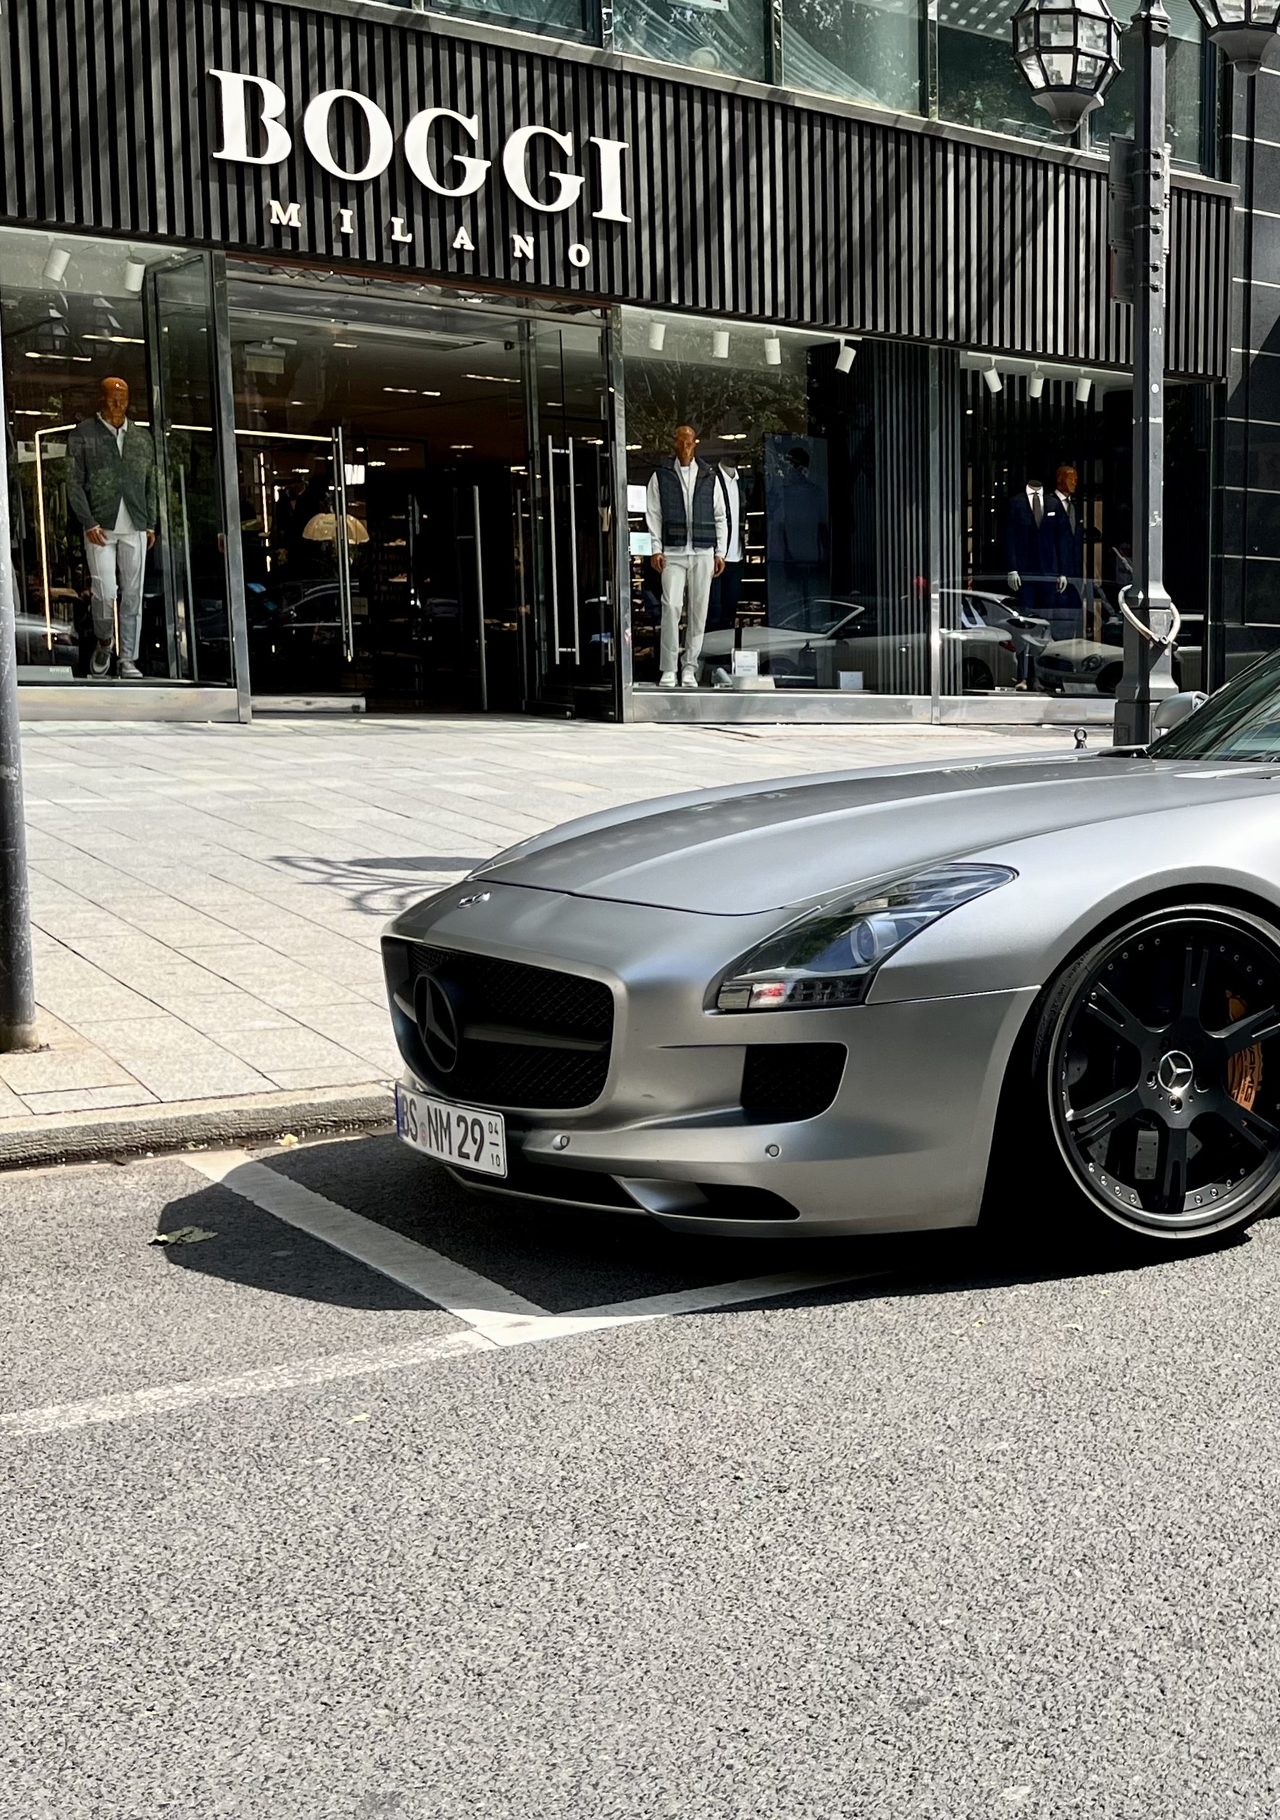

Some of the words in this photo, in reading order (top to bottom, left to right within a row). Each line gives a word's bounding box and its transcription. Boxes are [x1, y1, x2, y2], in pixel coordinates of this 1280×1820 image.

[209, 68, 632, 223] BOGGI
[269, 200, 591, 268] MILANO
[401, 1093, 418, 1143] BS
[427, 1104, 452, 1156] NM
[456, 1114, 485, 1163] 29
[488, 1121, 499, 1136] 04
[490, 1152, 501, 1167] 10
